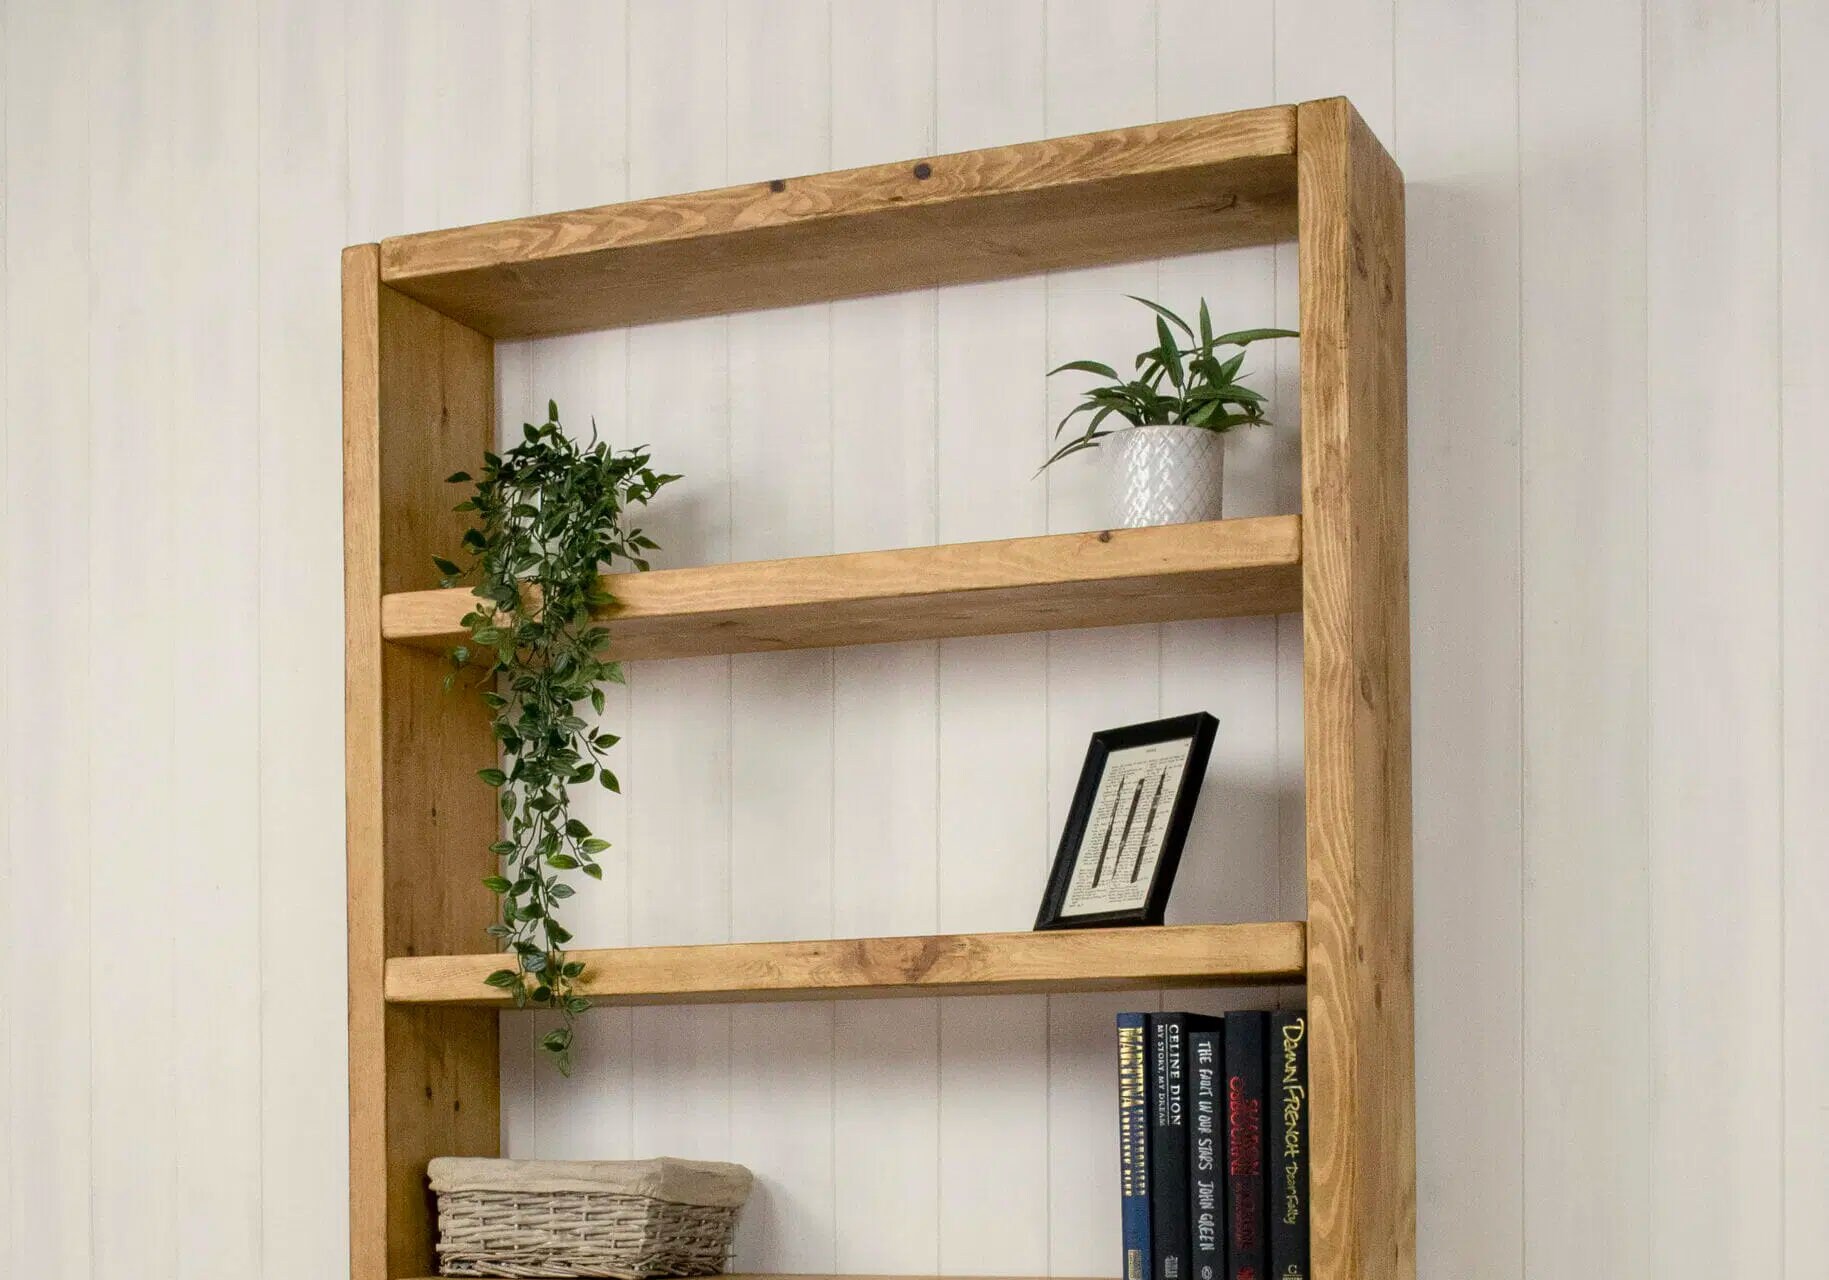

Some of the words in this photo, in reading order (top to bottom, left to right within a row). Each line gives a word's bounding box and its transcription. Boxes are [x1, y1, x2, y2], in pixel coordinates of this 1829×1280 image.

[1157, 1024, 1165, 1038] MY
[1168, 1024, 1180, 1079] CELINE
[1197, 1041, 1212, 1064] THE
[1158, 1076, 1165, 1089] MY
[1198, 1069, 1213, 1097] FAULT
[1158, 1093, 1166, 1126] DREAM
[1170, 1084, 1182, 1126] DION
[1198, 1101, 1213, 1113] IN
[1198, 1115, 1212, 1134] OUR
[1283, 1085, 1305, 1158] FRENCH
[1198, 1138, 1213, 1170] STARS
[1197, 1180, 1214, 1209] JOHN
[1197, 1213, 1215, 1251] GREEN
[1288, 1264, 1297, 1274] C
